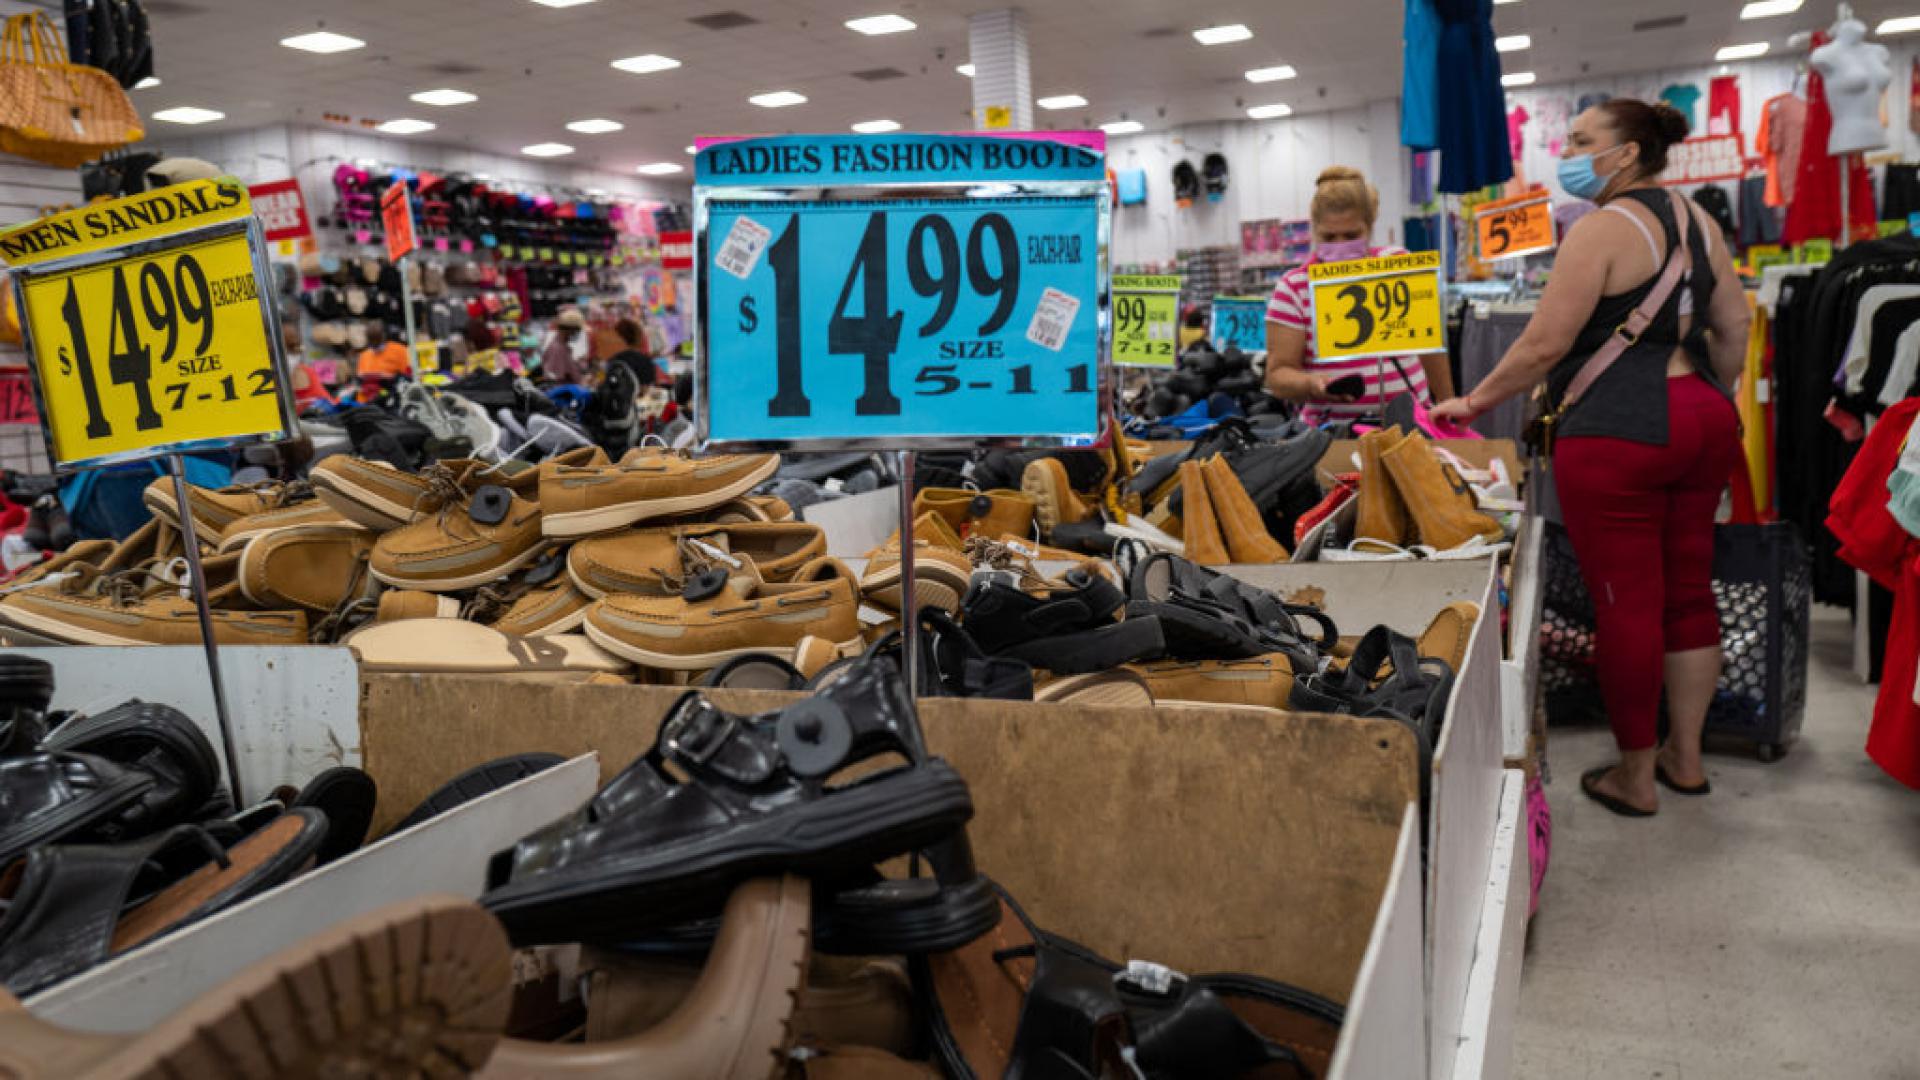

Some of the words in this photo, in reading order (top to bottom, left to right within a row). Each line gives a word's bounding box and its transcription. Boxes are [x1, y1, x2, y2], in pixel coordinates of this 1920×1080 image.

[709, 145, 823, 175] LADIES
[831, 143, 972, 173] FASHION
[983, 143, 1098, 170] BOOTS
[0, 218, 82, 260] MEN
[84, 183, 242, 239] SANDALS
[1312, 263, 1364, 279] LADIES
[1366, 254, 1437, 271] SLIPPERS
[939, 340, 1006, 360] SIZE
[177, 354, 223, 377] SIZE
